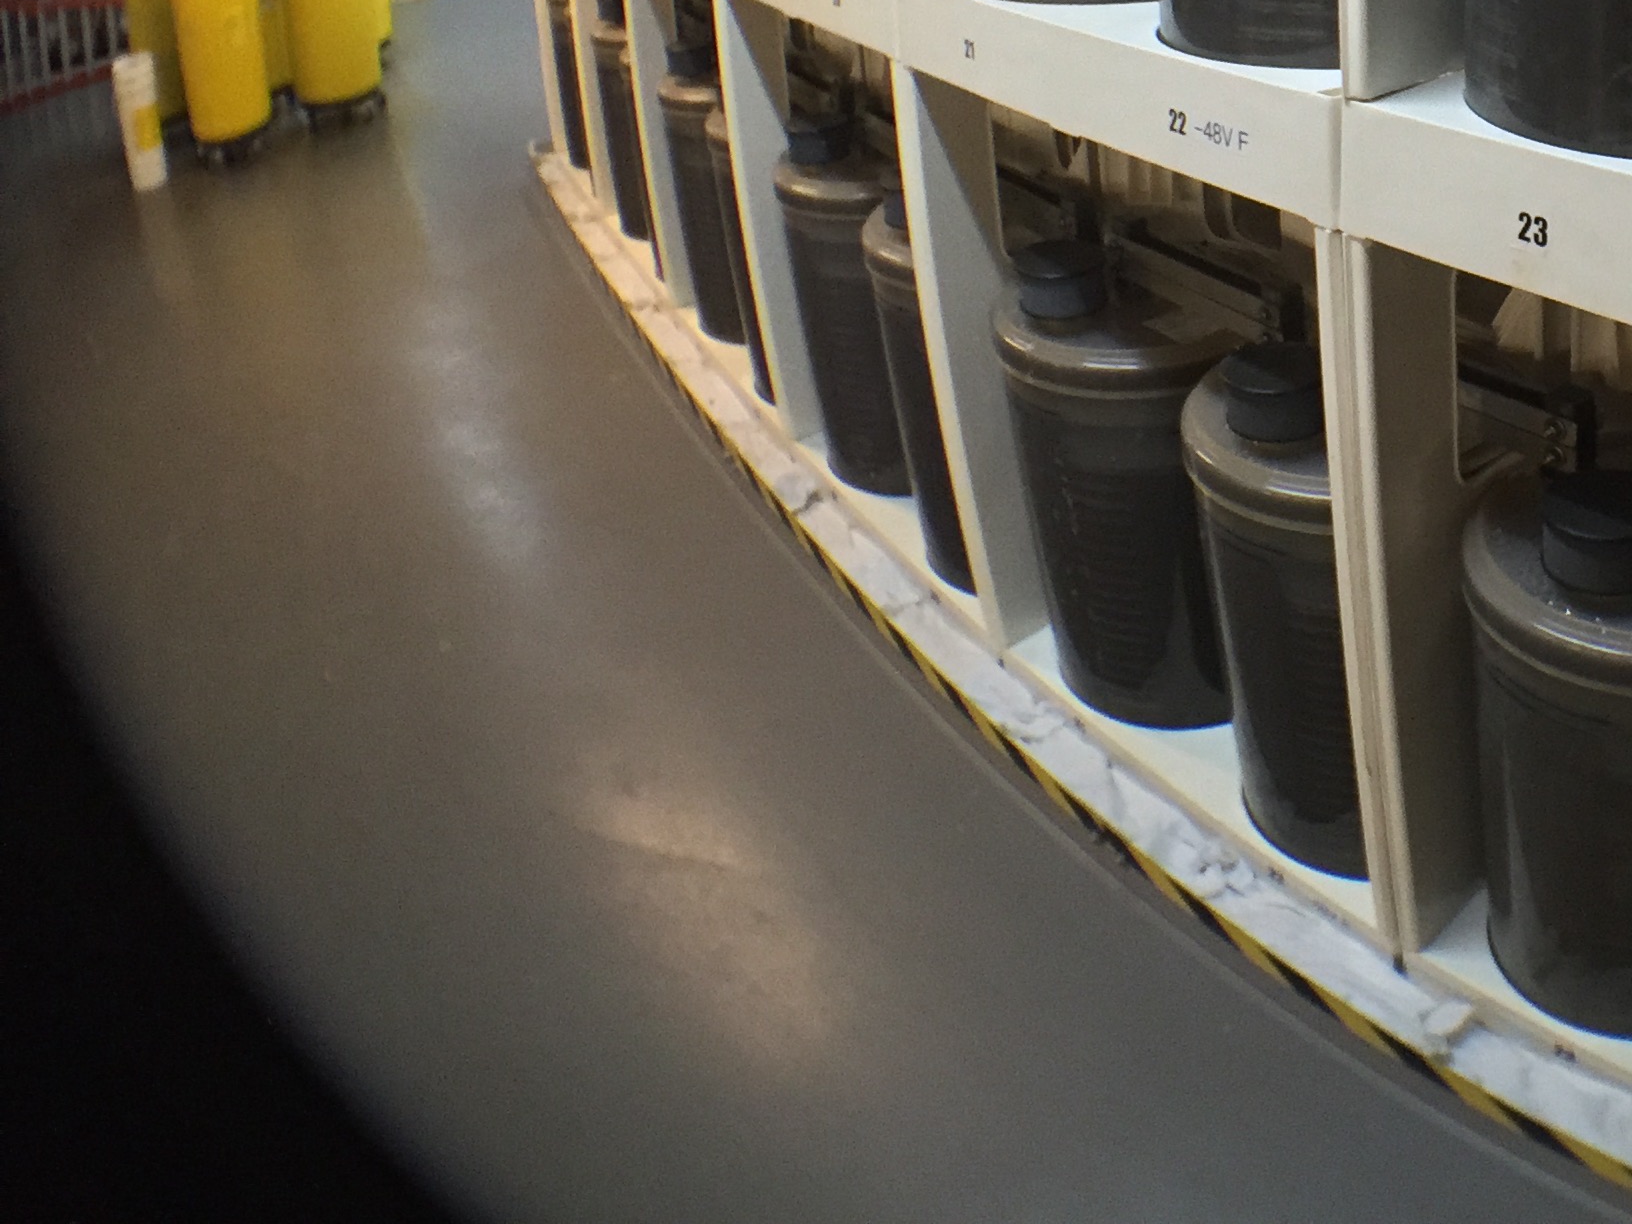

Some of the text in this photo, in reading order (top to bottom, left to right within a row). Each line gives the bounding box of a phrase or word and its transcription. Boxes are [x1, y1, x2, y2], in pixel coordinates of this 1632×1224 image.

[1168, 108, 1187, 136] 22
[1238, 130, 1249, 151] F
[1517, 211, 1548, 248] 23
